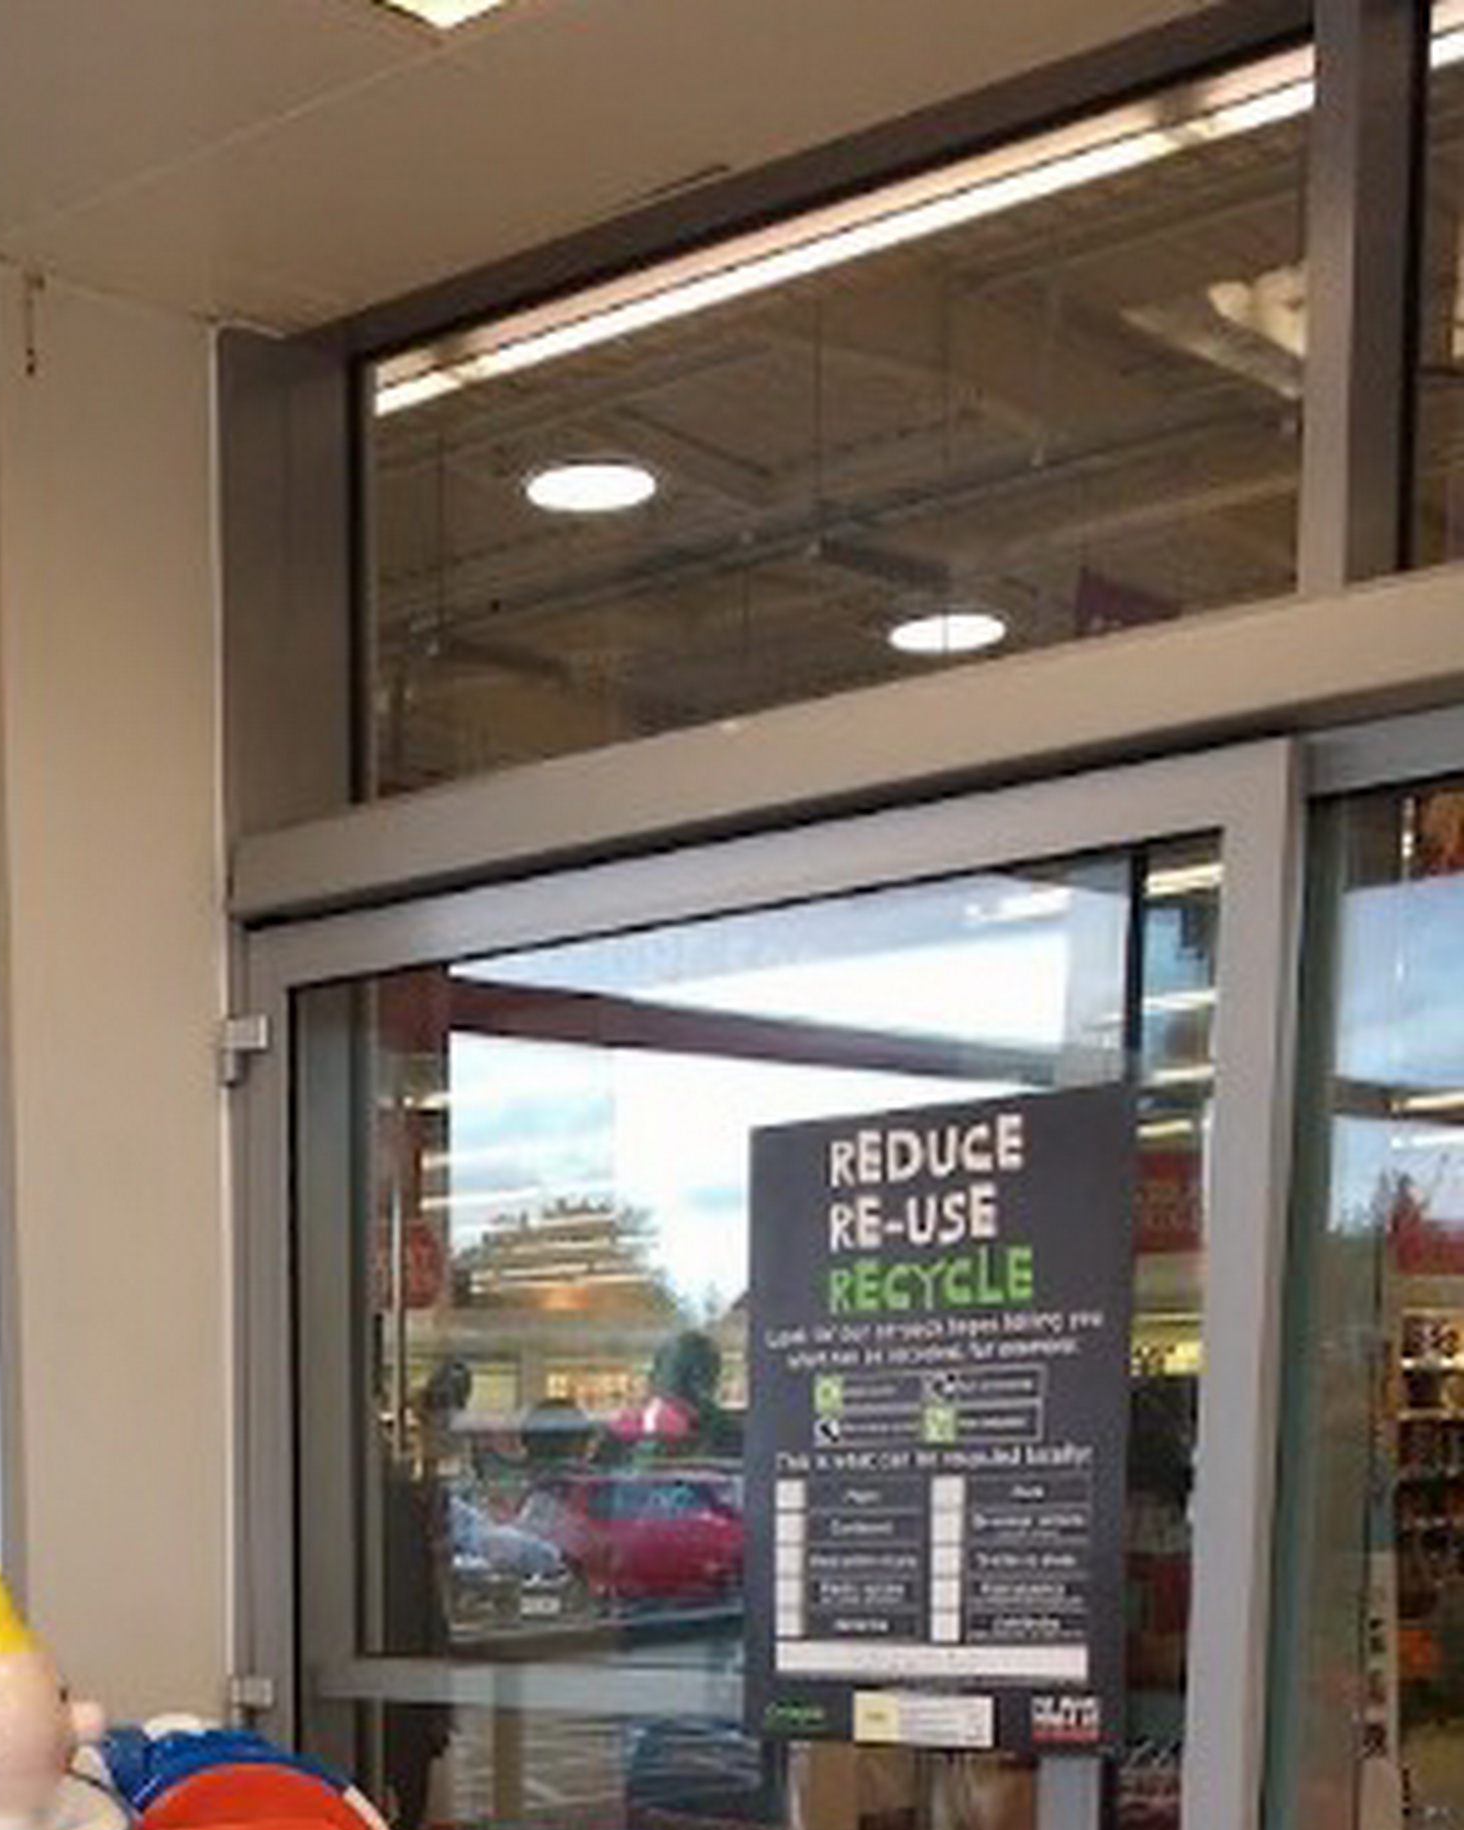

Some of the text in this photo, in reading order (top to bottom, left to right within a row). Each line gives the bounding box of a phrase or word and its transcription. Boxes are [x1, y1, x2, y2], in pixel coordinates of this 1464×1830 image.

[830, 1113, 1024, 1188] REDUCE
[830, 1183, 997, 1252] RE-USE
[830, 1245, 1034, 1314] RECYCLE
